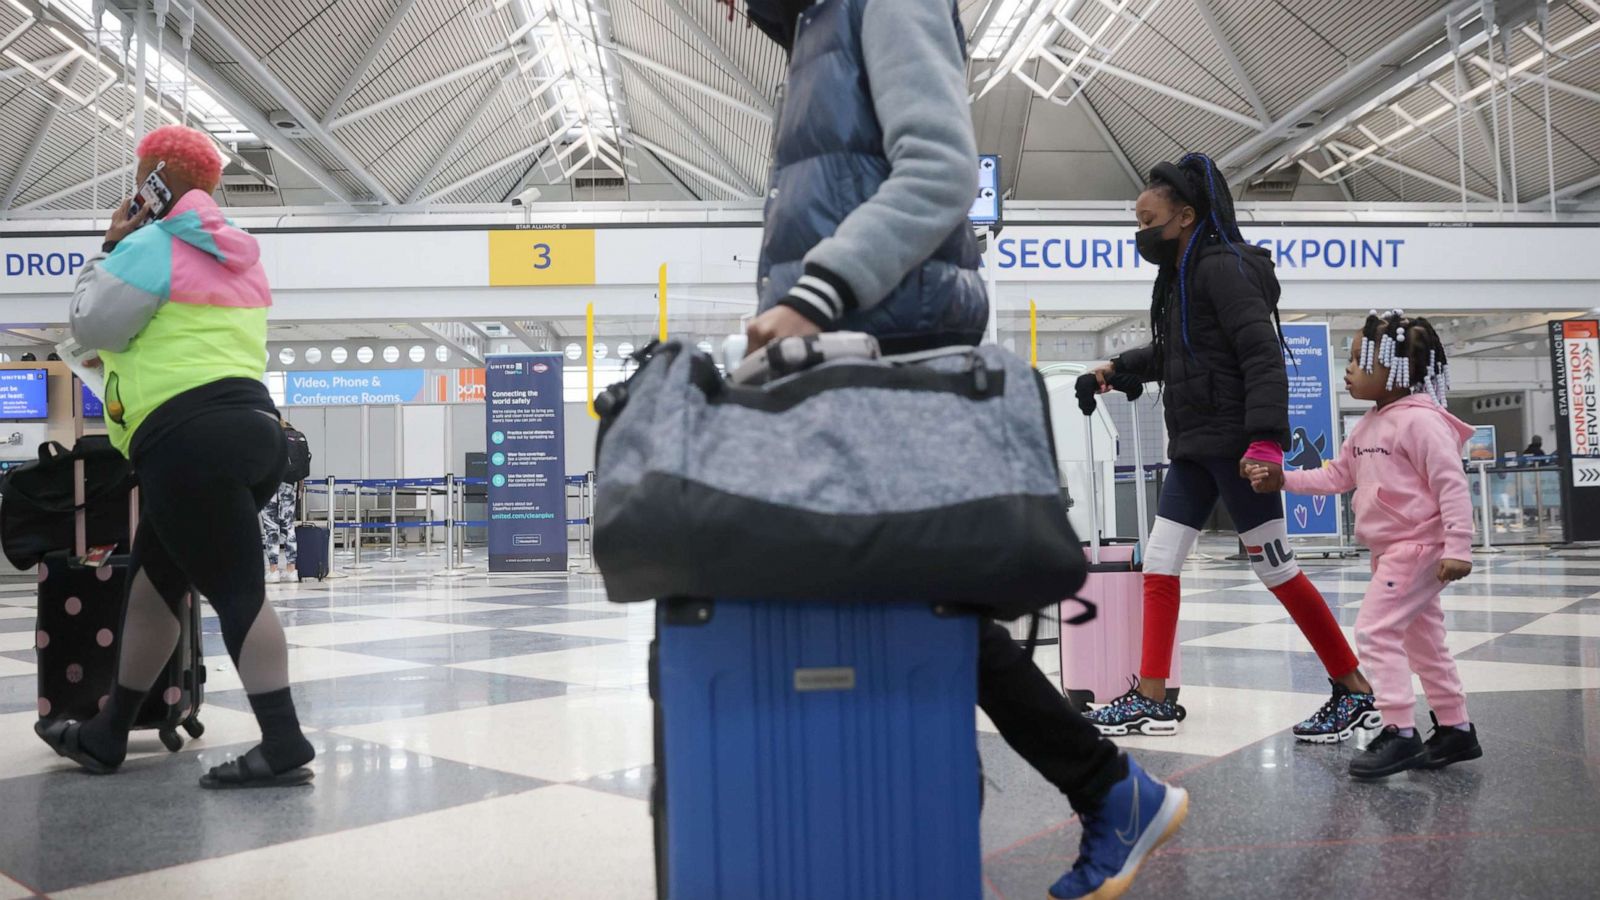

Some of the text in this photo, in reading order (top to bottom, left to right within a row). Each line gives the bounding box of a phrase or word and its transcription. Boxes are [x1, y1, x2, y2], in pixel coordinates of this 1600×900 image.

[6, 253, 84, 275] DROP
[533, 243, 552, 270] 3
[998, 238, 1140, 269] SECURIT
[1245, 239, 1405, 268] KPOINT
[1283, 336, 1311, 347] Family
[293, 375, 382, 389] Video, Phone &
[1553, 334, 1568, 417] STAR ALLIANCE
[293, 393, 359, 404] Conference
[492, 390, 527, 398] Connecting
[1569, 342, 1588, 456] CONNECTION
[1584, 384, 1600, 457] SERVICE
[491, 512, 555, 520] united.com/cleanplus
[1246, 538, 1294, 567] FIL
